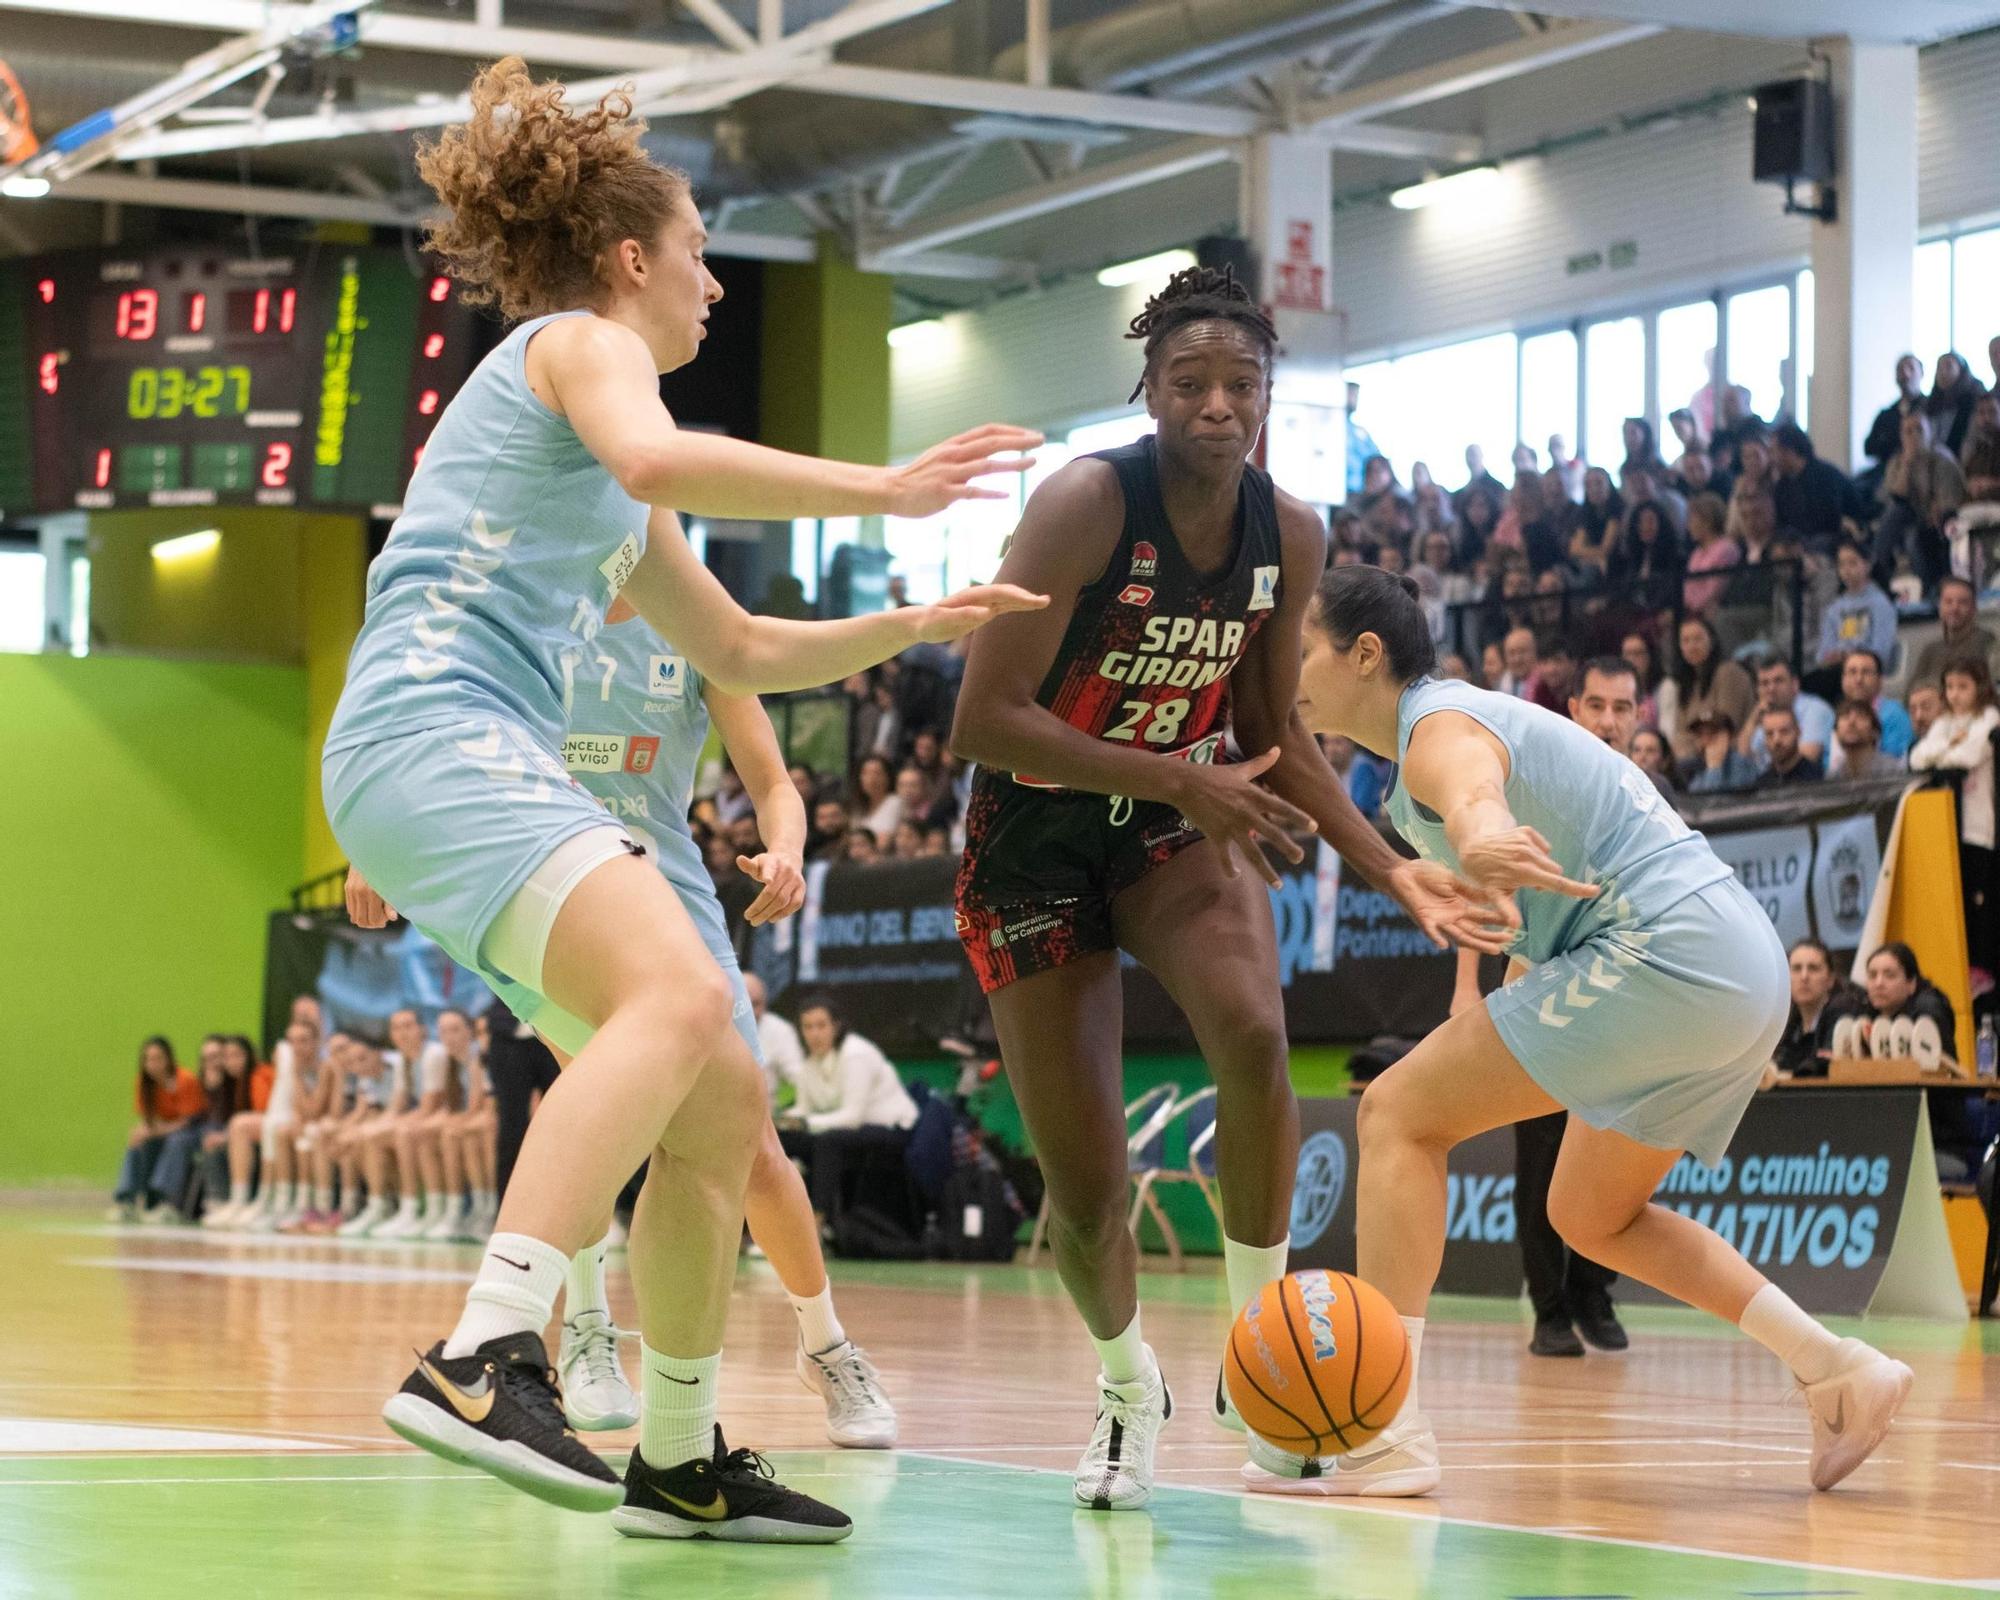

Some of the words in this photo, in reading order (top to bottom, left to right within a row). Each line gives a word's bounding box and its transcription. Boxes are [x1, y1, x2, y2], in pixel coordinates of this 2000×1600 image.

[116, 288, 159, 340] 13
[189, 293, 206, 333] 1
[252, 287, 296, 333] 11
[128, 365, 251, 420] 03:27
[96, 447, 112, 488] 1
[262, 441, 292, 487] 2
[1139, 616, 1246, 658] SPAR
[1098, 651, 1238, 690] GIRON
[1102, 698, 1190, 743] 28
[579, 753, 609, 764] VIGO
[1739, 1140, 1889, 1197] caminos
